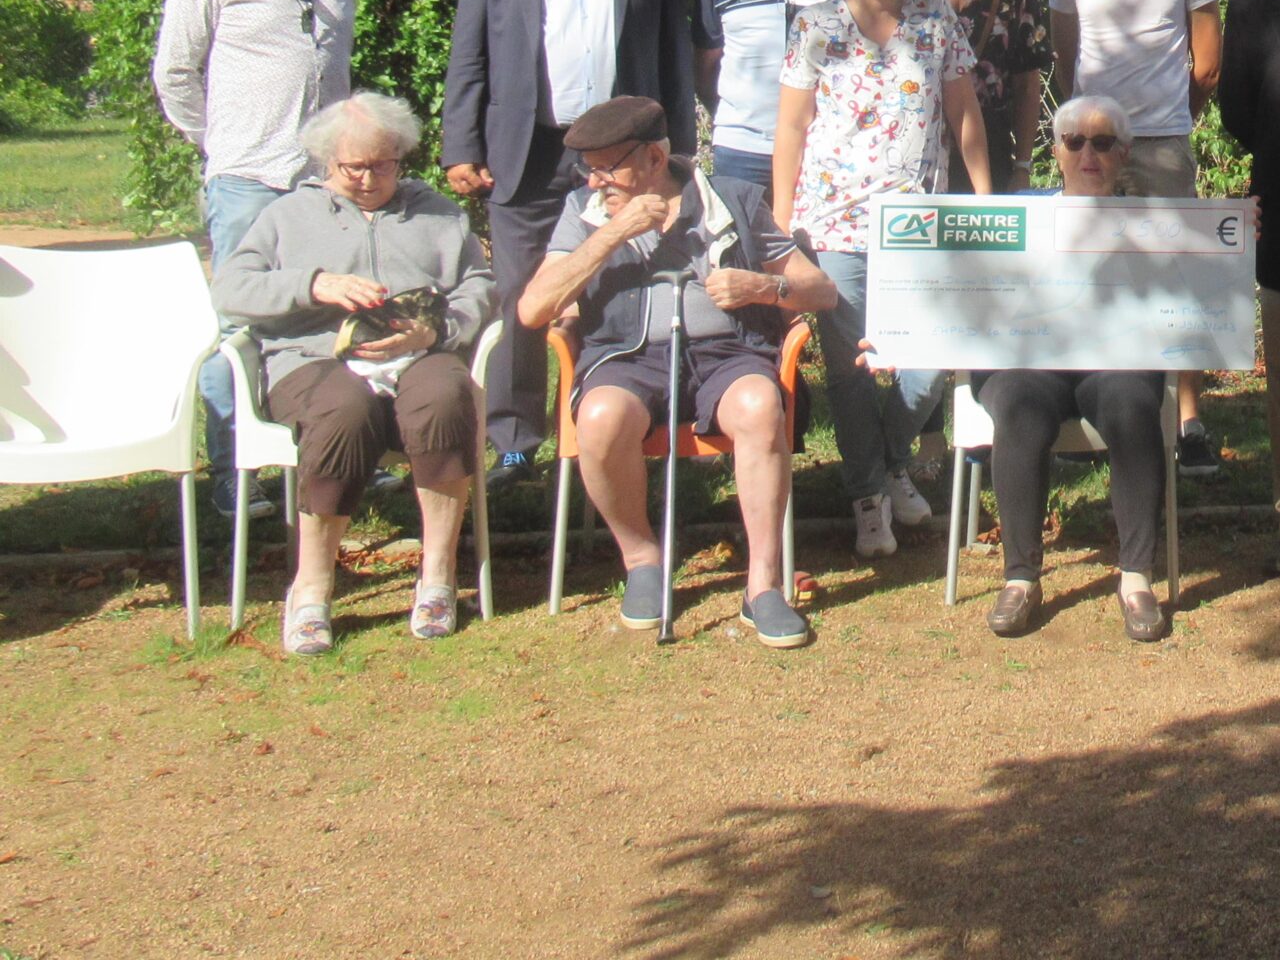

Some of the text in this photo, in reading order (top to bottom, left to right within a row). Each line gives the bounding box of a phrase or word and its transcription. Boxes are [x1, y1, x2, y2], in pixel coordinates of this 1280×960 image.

[943, 213, 1020, 228] CENTRE
[1135, 219, 1182, 239] 500
[943, 229, 1020, 244] FRANCE
[1215, 216, 1239, 247] €
